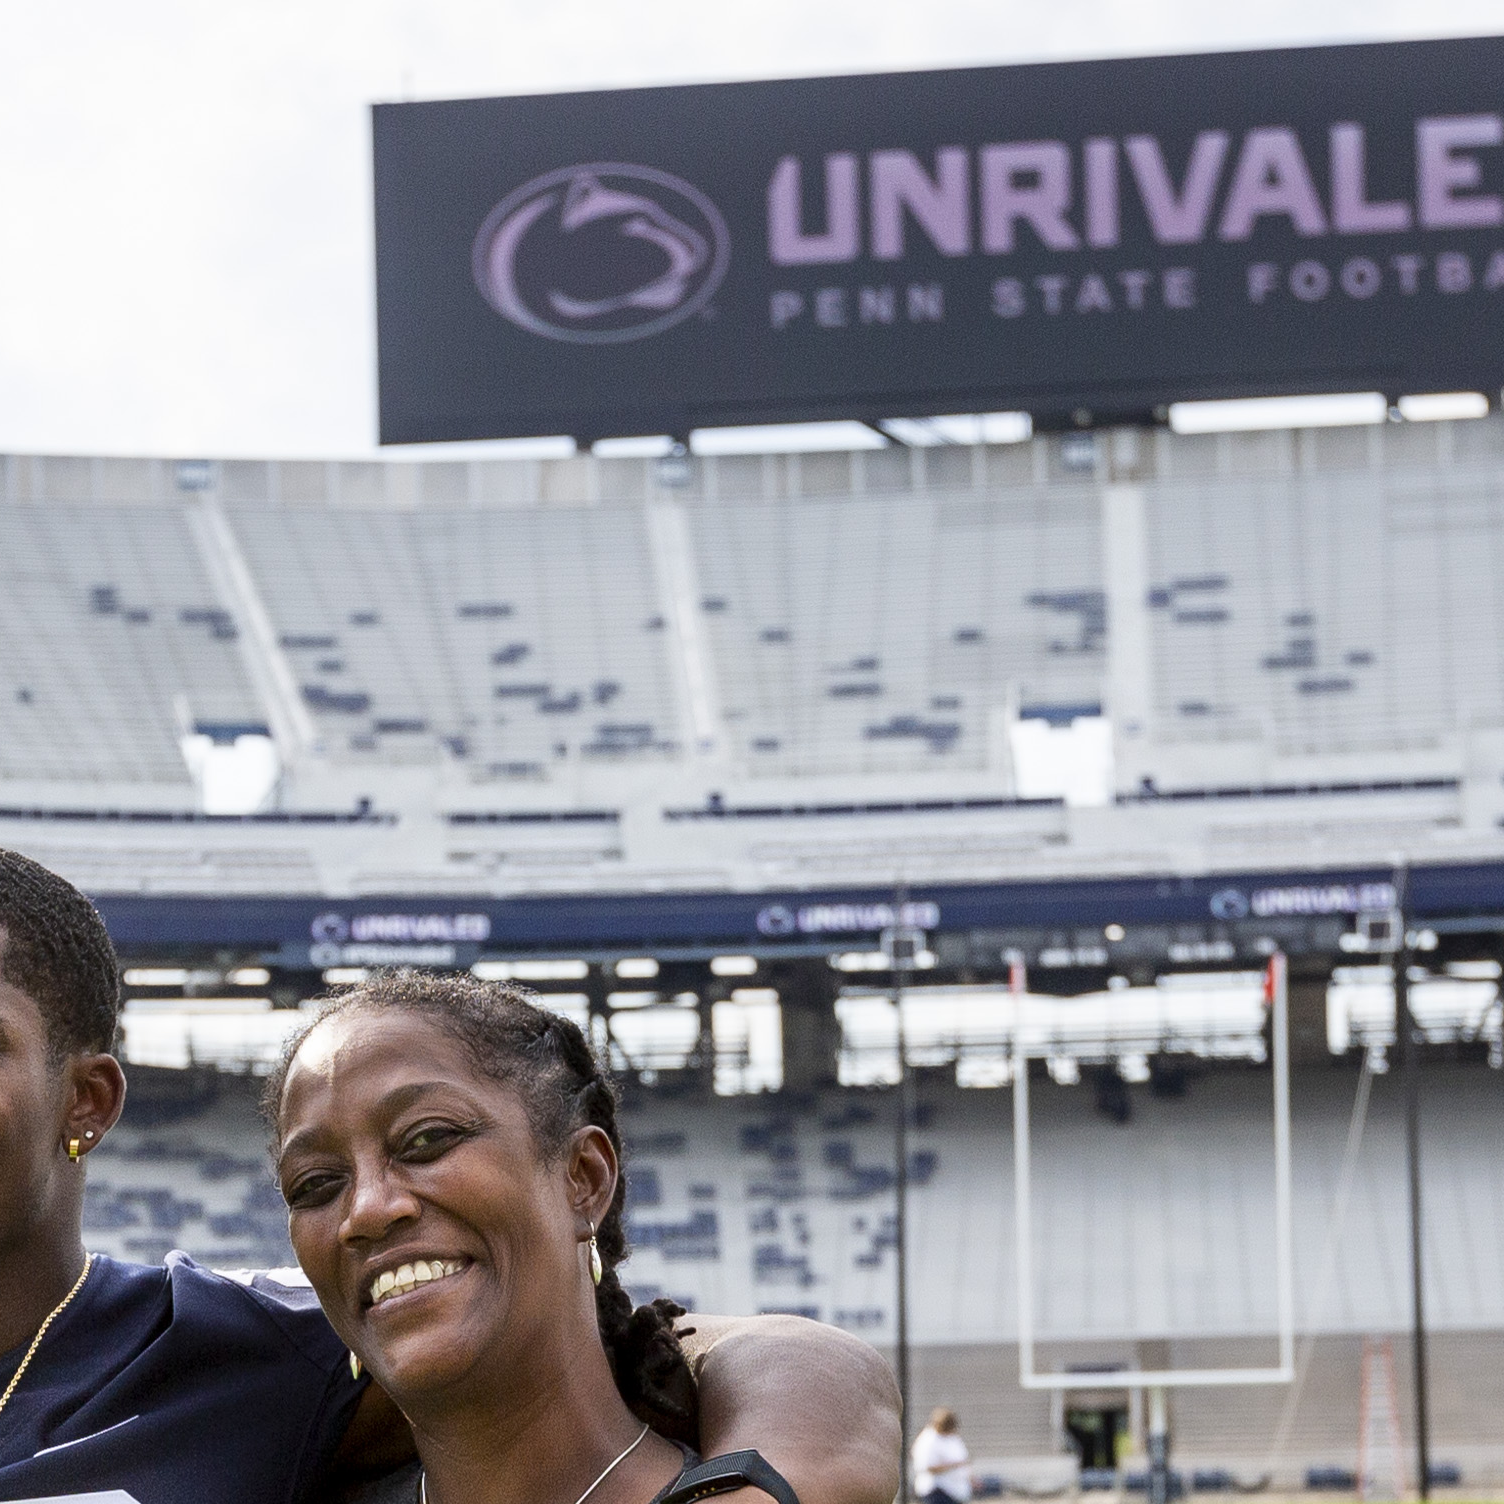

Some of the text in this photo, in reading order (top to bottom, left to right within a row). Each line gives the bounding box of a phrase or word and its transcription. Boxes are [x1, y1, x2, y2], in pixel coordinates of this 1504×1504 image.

[770, 282, 945, 329] PENN
[992, 267, 1198, 319] STATE
[351, 912, 491, 942] UNRIVALED
